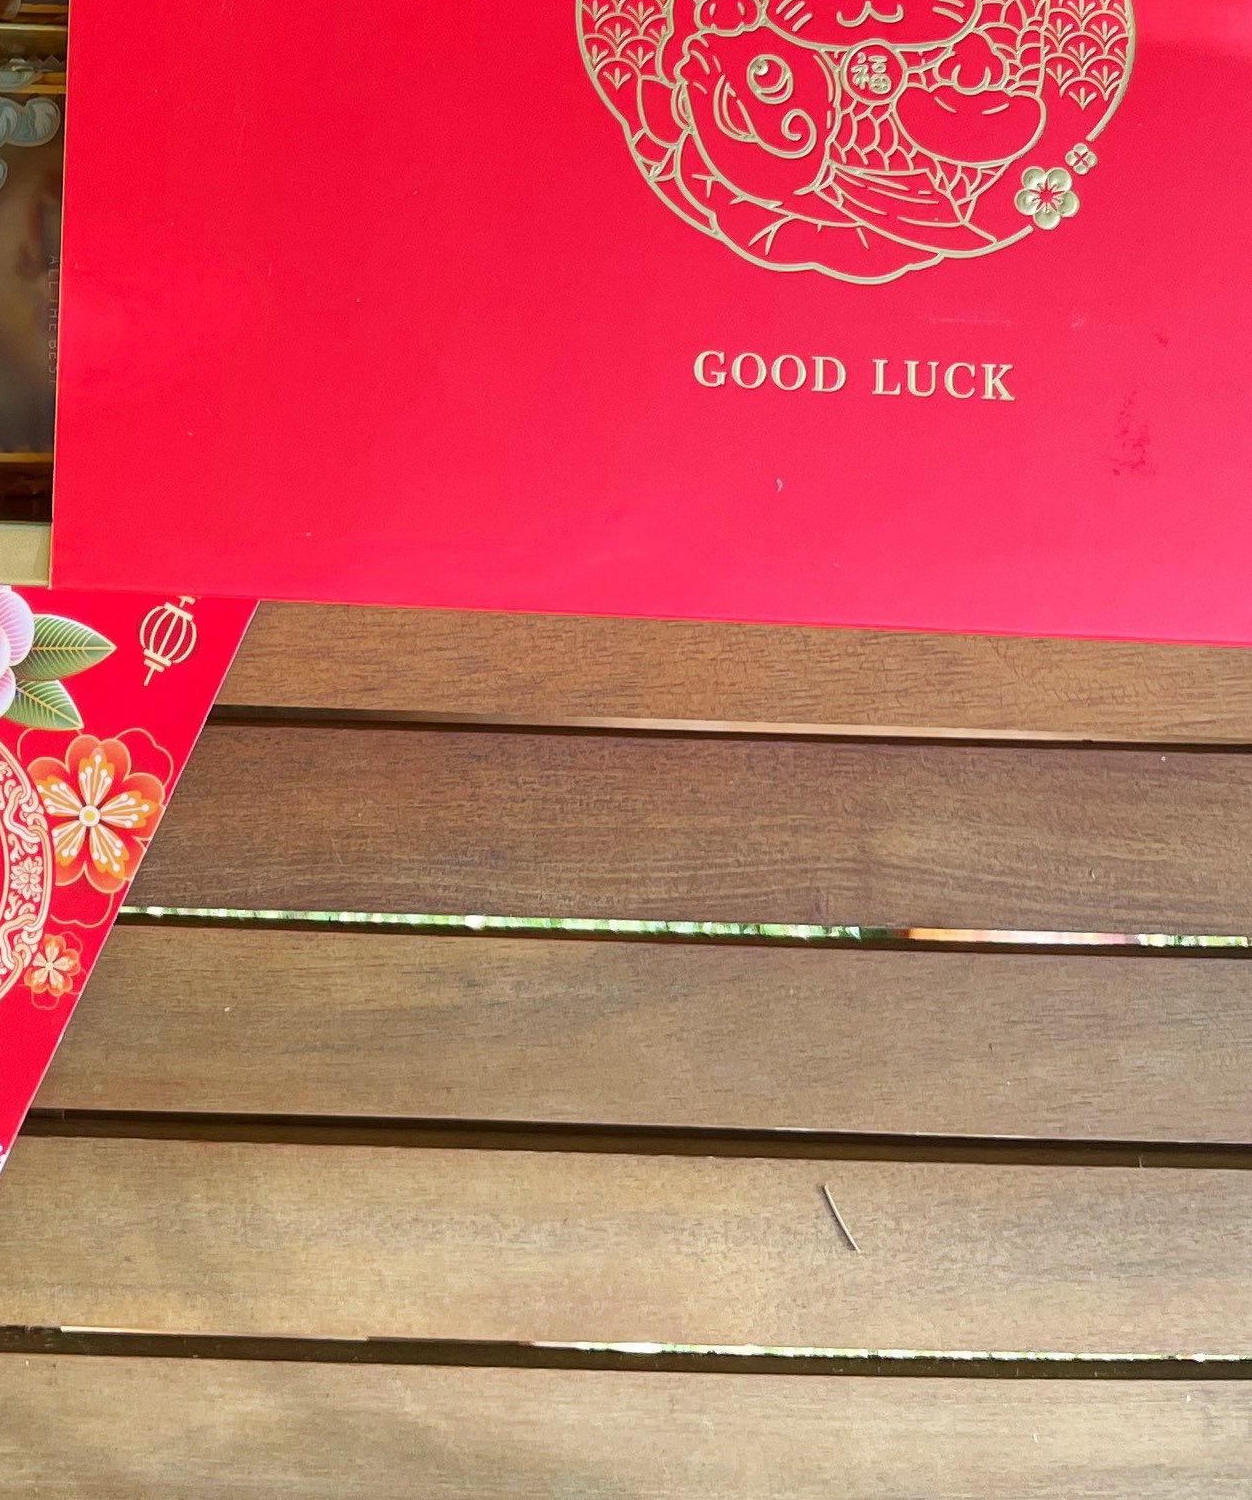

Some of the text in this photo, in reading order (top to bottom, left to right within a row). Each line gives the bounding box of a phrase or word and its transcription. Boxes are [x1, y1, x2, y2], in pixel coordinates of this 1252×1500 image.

[851, 52, 892, 95] 福
[693, 350, 1015, 401] GOOD LUCK
